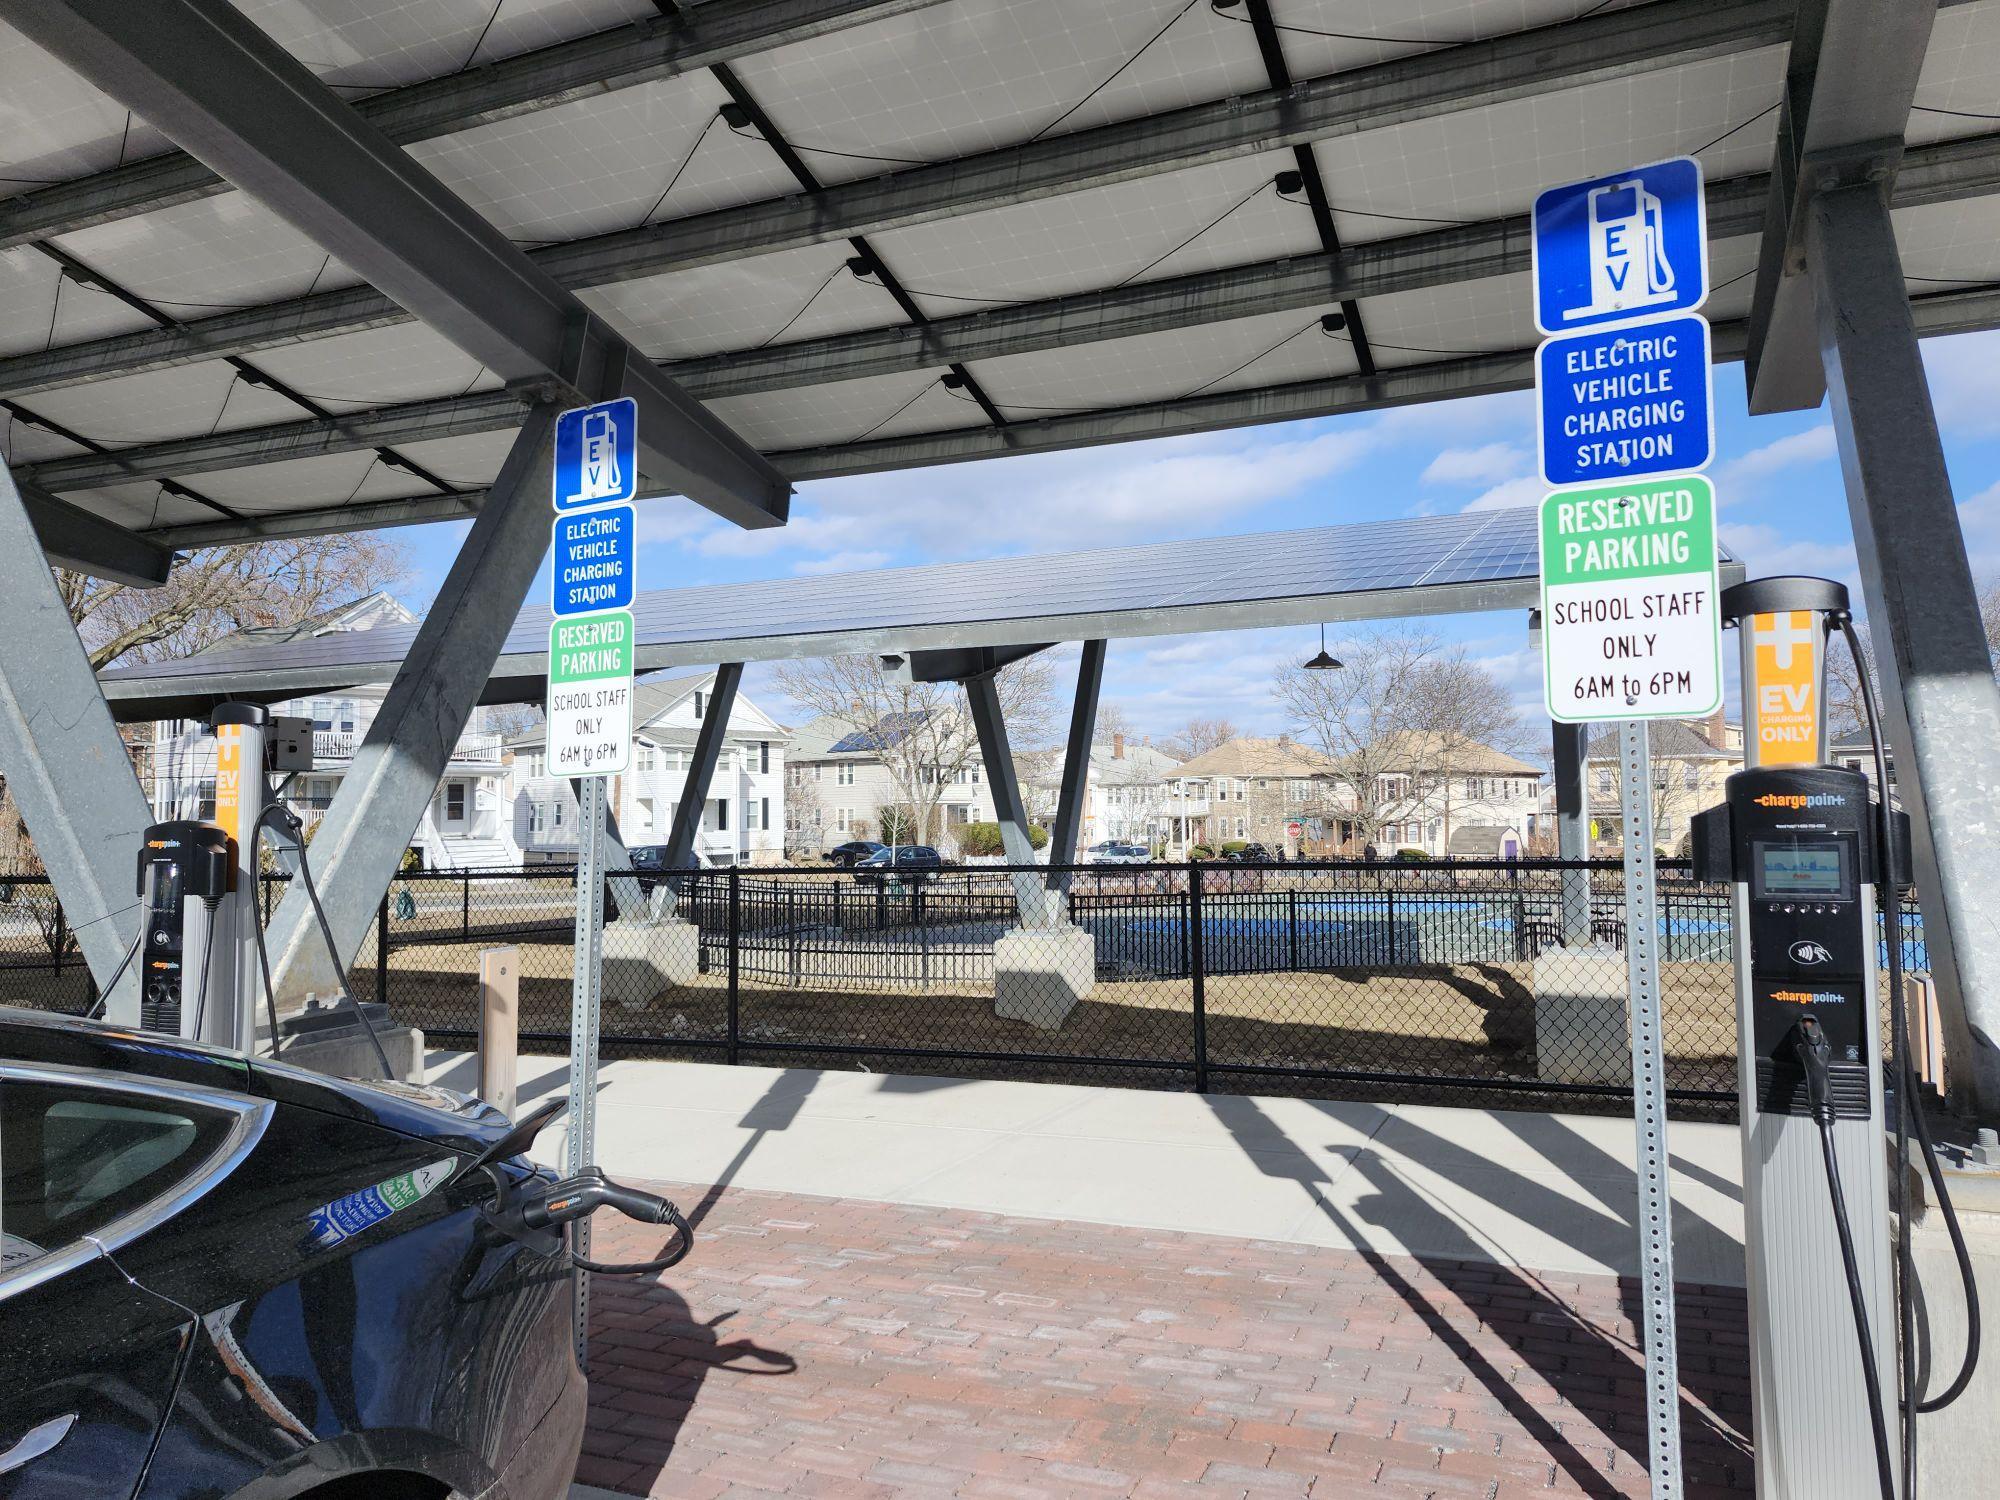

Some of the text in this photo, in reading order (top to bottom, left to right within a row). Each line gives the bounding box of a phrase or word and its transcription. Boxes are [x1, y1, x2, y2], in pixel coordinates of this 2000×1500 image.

[1567, 335, 1677, 374] ELECTRIC
[1573, 369, 1673, 404] VEHICLE
[1564, 399, 1685, 437] CHARGING
[1576, 433, 1673, 467] STATION
[1558, 489, 1694, 535] RESERVED
[567, 517, 621, 540] ELECTRIC
[569, 539, 617, 561] VEHICLE
[1565, 531, 1690, 573] PARKING
[564, 560, 622, 583] CHARGING
[569, 583, 616, 604] STATION
[1555, 591, 1705, 625] SCHOOL STAFF
[559, 620, 624, 649] RESERVED
[1603, 634, 1657, 660] ONLY
[561, 648, 621, 676] PARKING
[1574, 670, 1691, 699] 6AM to 6PM
[554, 688, 627, 711] SCHOOL STAFF
[1760, 683, 1811, 714] EV
[576, 718, 603, 735] ONLY
[1761, 713, 1812, 725] CHARGING
[1761, 726, 1813, 743] ONLY
[560, 743, 617, 763] 6AM to 6PM
[217, 770, 239, 789] EV
